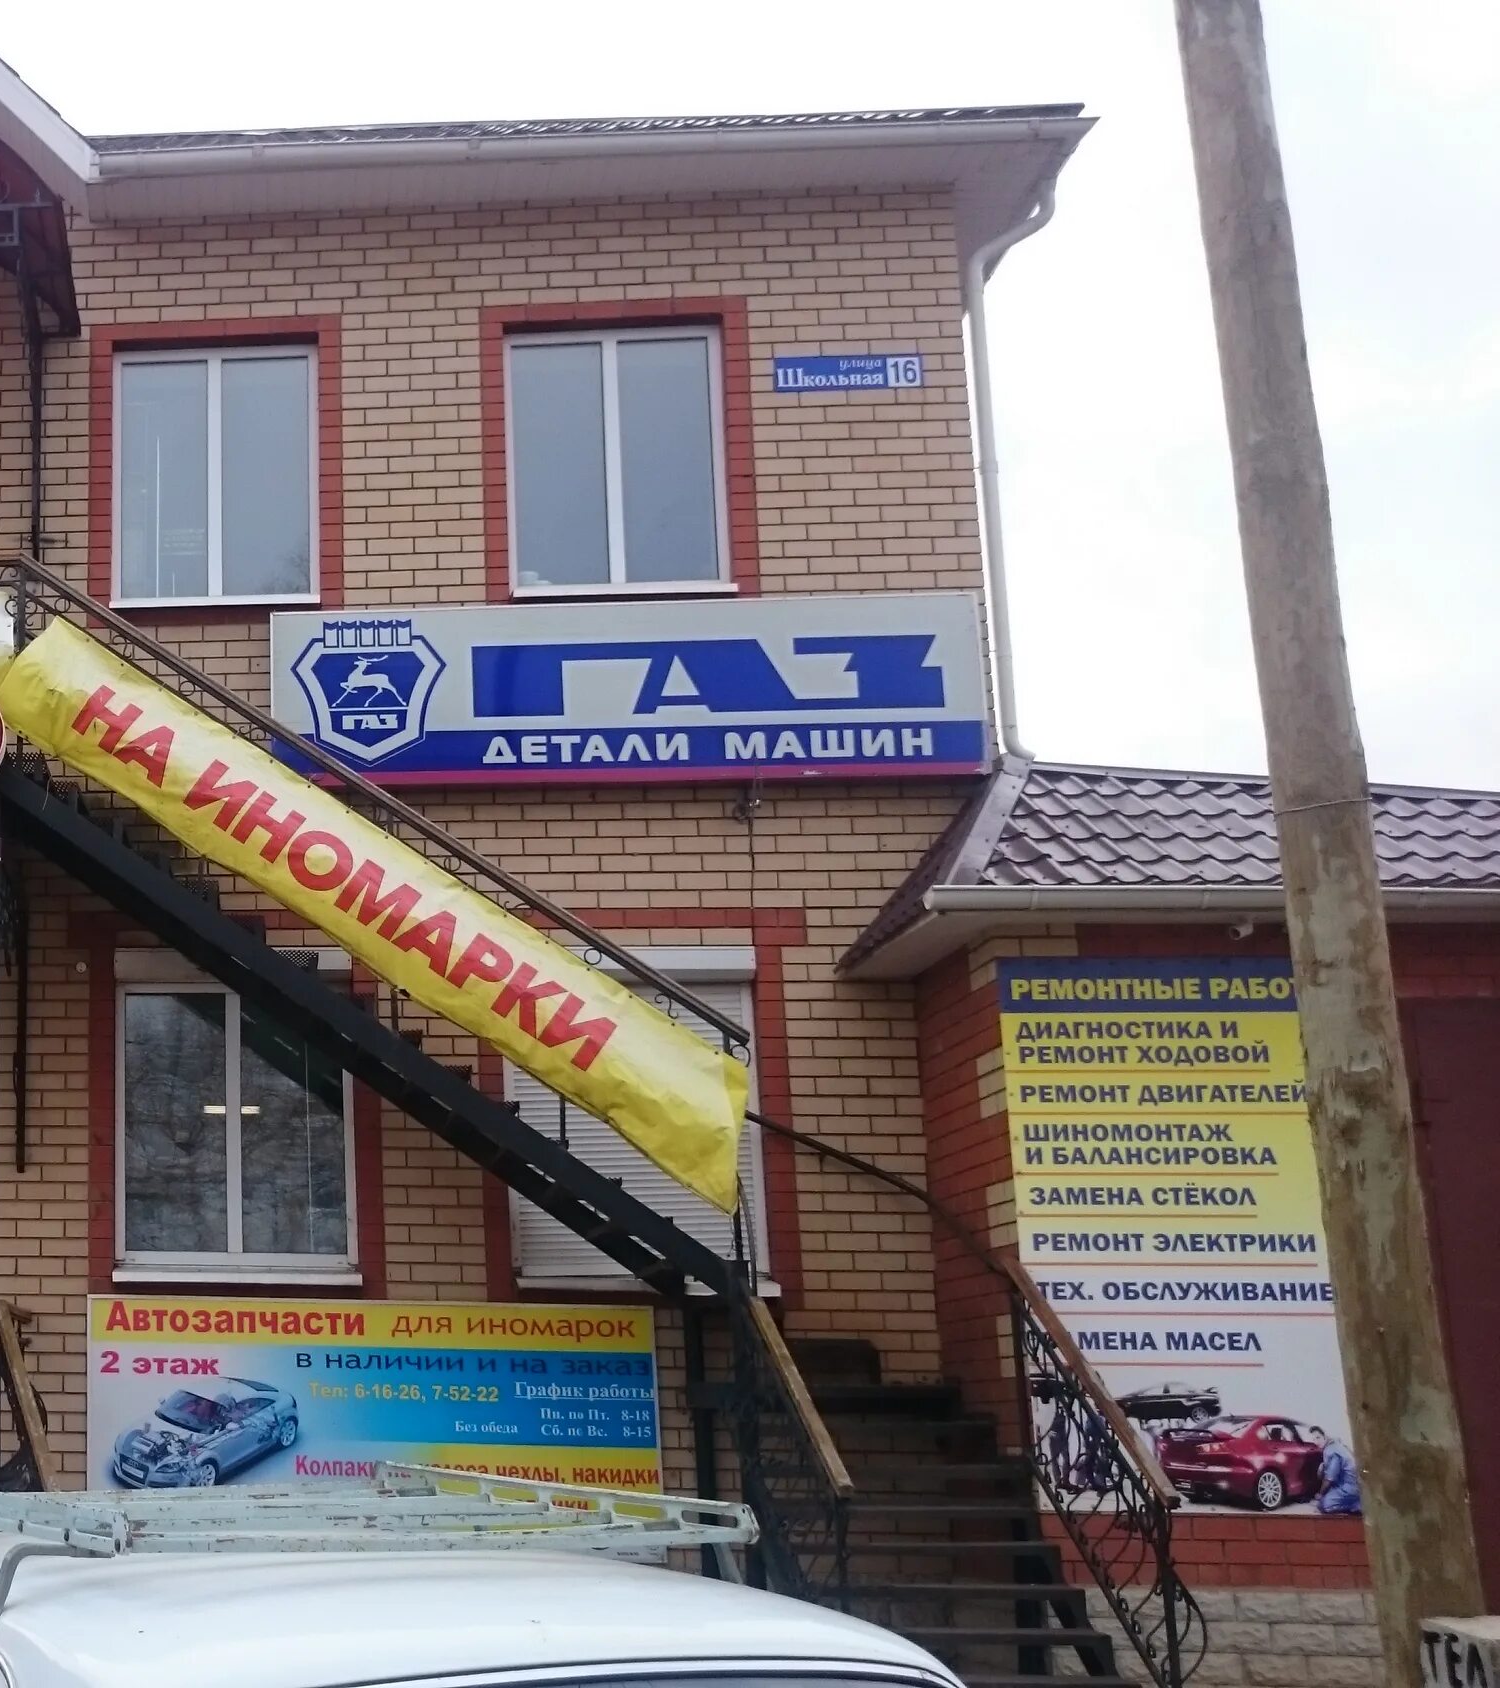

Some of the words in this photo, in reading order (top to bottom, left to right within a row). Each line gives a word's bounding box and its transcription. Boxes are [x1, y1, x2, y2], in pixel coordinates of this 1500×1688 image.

[776, 367, 884, 388] Школьная
[890, 360, 917, 384] 16
[839, 359, 882, 371] улица
[471, 634, 946, 719] ГАЗ
[342, 714, 398, 731] ГАЗ
[483, 733, 691, 765] ДЕТАЛИ
[725, 728, 934, 760] МАШИН
[71, 685, 176, 788] НА
[183, 758, 618, 1073] ИНОМАРКИ
[1010, 978, 1201, 1000] РЕМОНТНЫЕ
[1016, 1021, 1212, 1042] ДИАГНОСТИКА
[1220, 1021, 1239, 1039] И
[1019, 1046, 1128, 1064] РЕМОНТ
[1137, 1040, 1269, 1067] ХОДОВОЙ
[1020, 1085, 1130, 1103] РЕМОНТ
[1138, 1079, 1307, 1106] ДВИГАТЕЛЕЙ
[1023, 1123, 1233, 1142] ШИНОМОНТАЖ
[1025, 1148, 1043, 1165] И
[1052, 1147, 1277, 1165] БАЛАНСИРОВКА
[1029, 1187, 1144, 1206] ЗАМЕНА
[1152, 1182, 1257, 1206] СТЁКОЛ
[1032, 1233, 1144, 1251] РЕМОНТ
[1152, 1233, 1316, 1252] ЭЛЕКТРИКИ
[1036, 1281, 1094, 1300] ТЕХ.
[1102, 1281, 1334, 1302] ОБСЛУЖИВАНИЕ
[105, 1300, 365, 1336] Автозапчасти
[391, 1314, 452, 1338] для
[467, 1316, 636, 1343] иномарок
[1077, 1331, 1158, 1351] МЕНА
[1166, 1331, 1262, 1351] МАСЕЛ
[99, 1350, 120, 1374] 2
[132, 1356, 219, 1375] этаж
[295, 1352, 312, 1368] в
[325, 1352, 464, 1373] наличии
[477, 1357, 497, 1373] и
[509, 1358, 548, 1374] на
[561, 1358, 650, 1377] заказ
[309, 1382, 348, 1399] Тел:
[354, 1383, 427, 1402] 6-16-26,
[432, 1385, 499, 1403] 7-52-22
[514, 1382, 584, 1400] График
[589, 1383, 656, 1401] работы
[540, 1407, 564, 1420] Пн.
[568, 1411, 584, 1421] по
[588, 1408, 610, 1421] Пт.
[620, 1409, 651, 1422] 8-18
[454, 1420, 478, 1433] Без
[480, 1421, 518, 1435] обеда
[540, 1423, 564, 1437] Сб.
[587, 1425, 608, 1437] Вс.
[622, 1426, 652, 1438] 8-15
[573, 1467, 659, 1487] накидки
